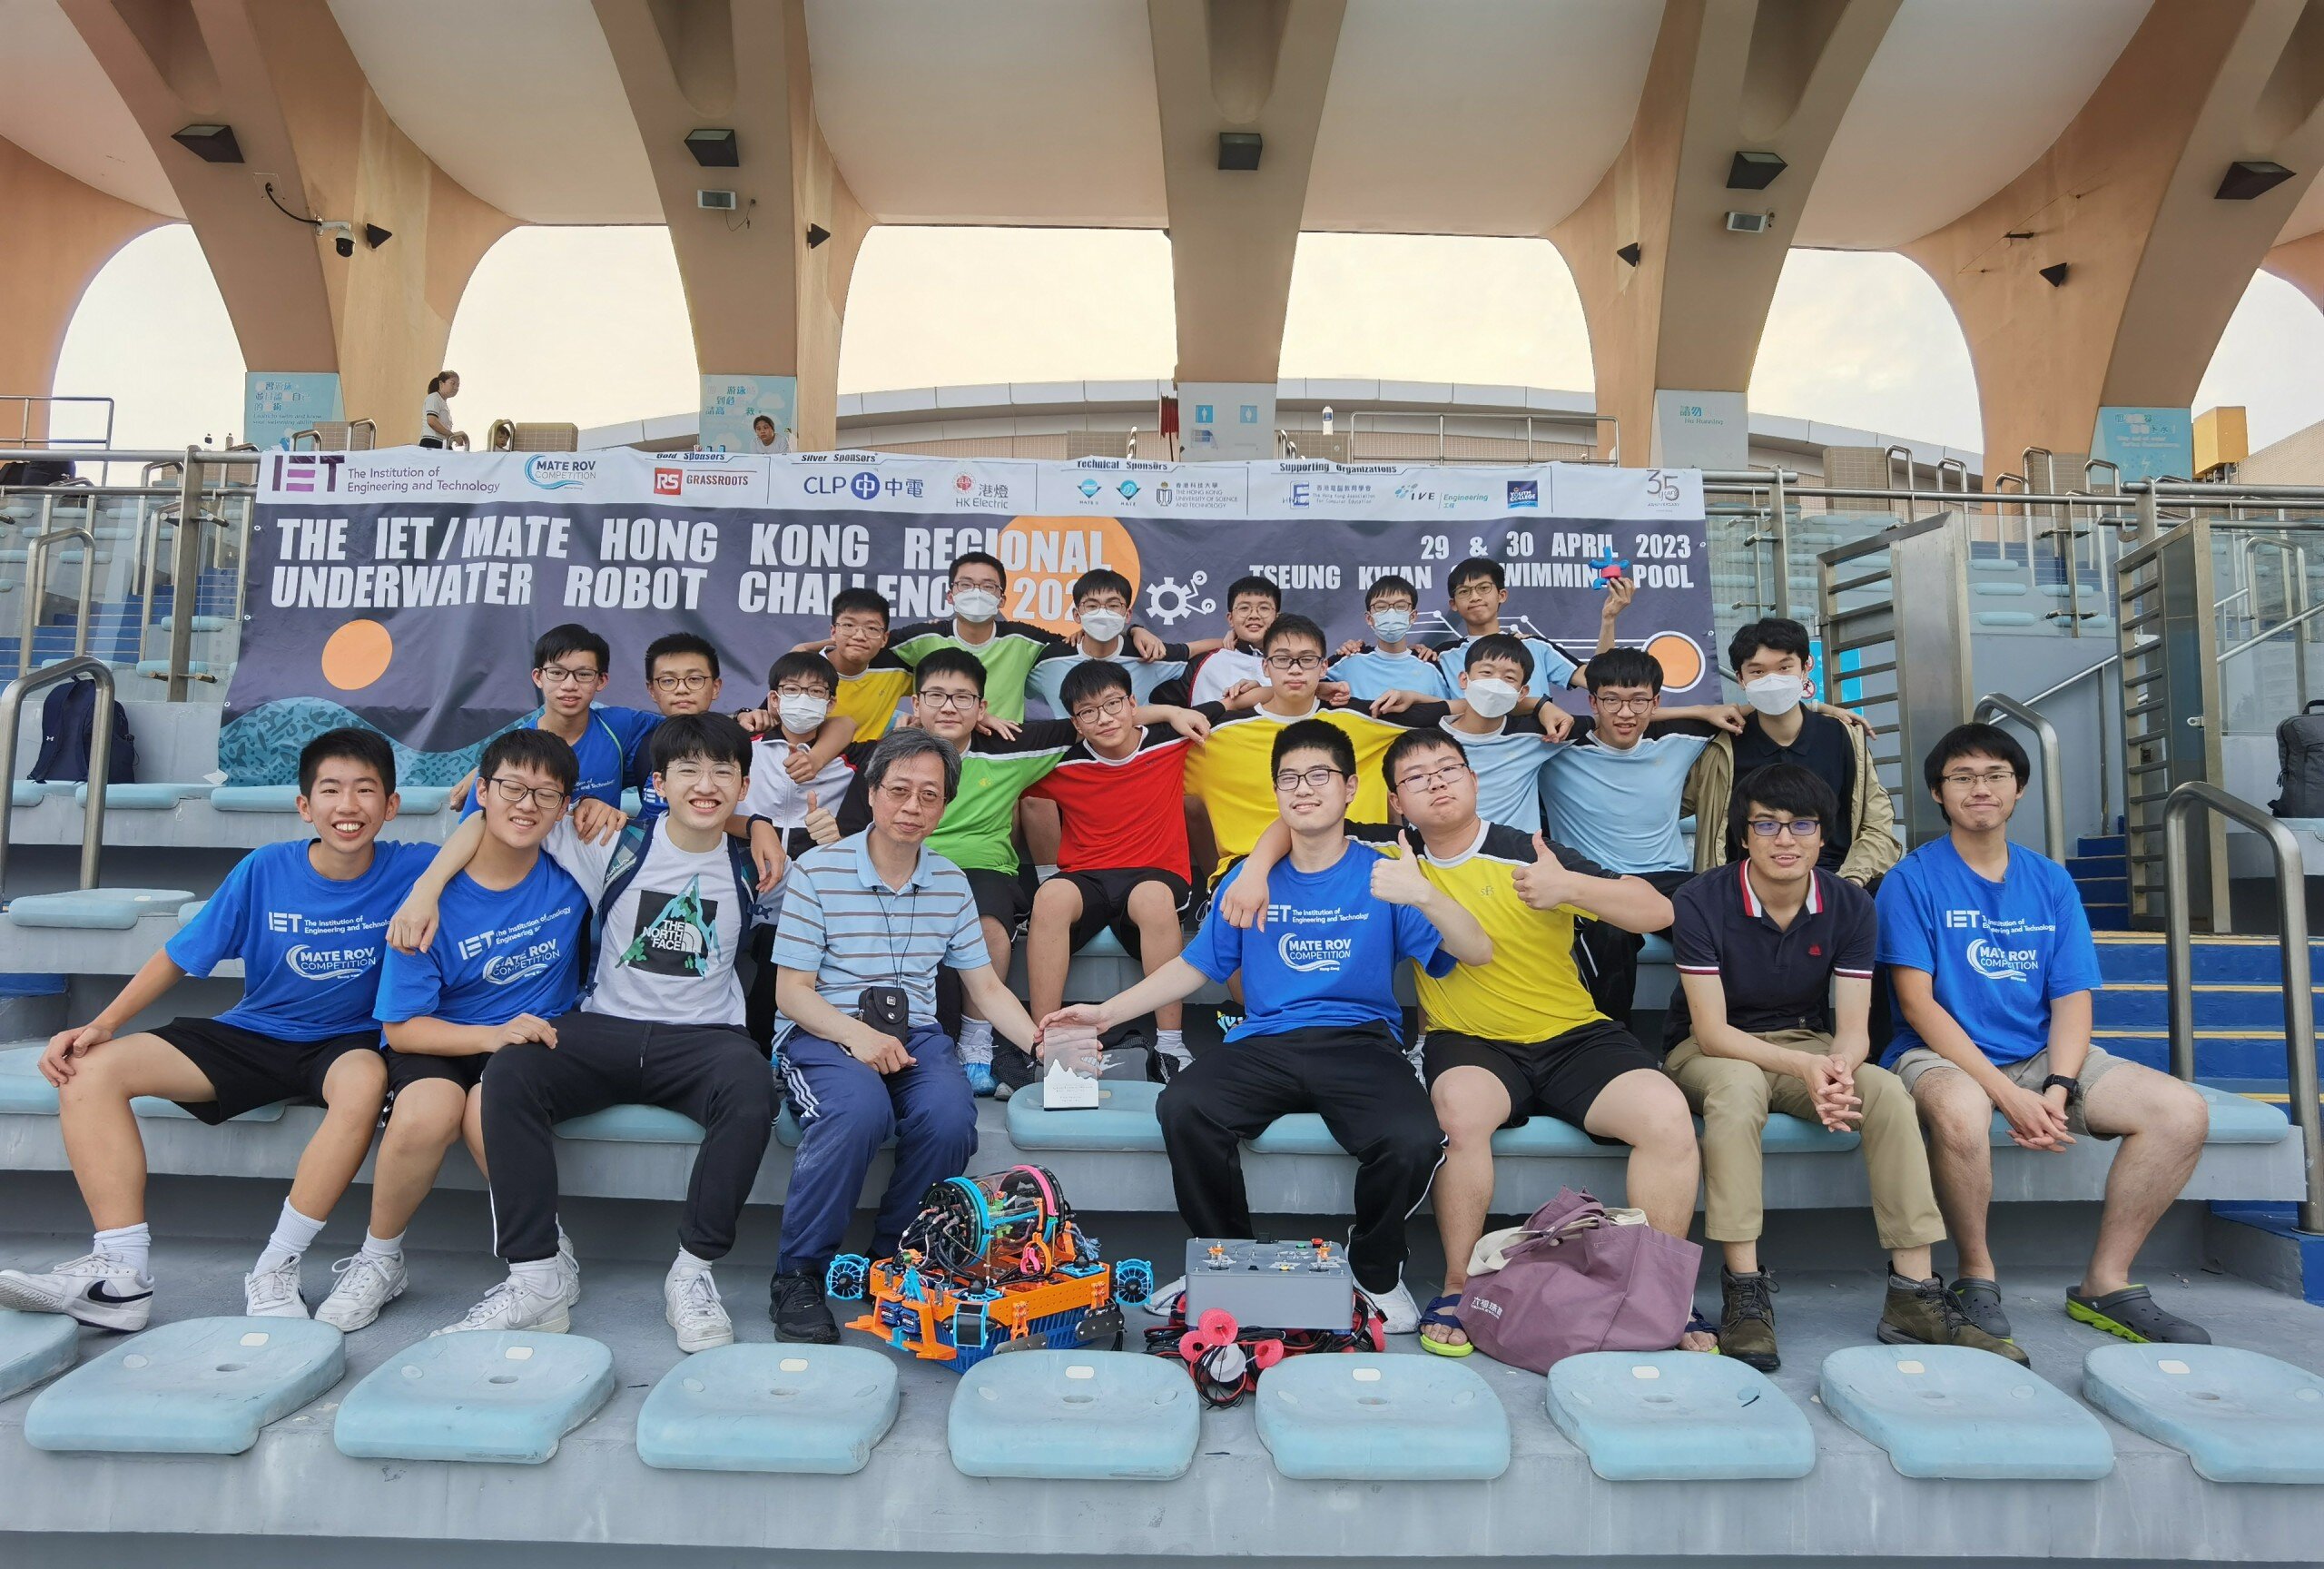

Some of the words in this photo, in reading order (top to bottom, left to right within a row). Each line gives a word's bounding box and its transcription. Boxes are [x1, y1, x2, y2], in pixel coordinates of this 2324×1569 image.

[537, 460, 569, 471] MATE
[572, 460, 596, 471] ROV
[684, 453, 725, 463] Sponsors
[801, 454, 828, 463] Silver
[833, 453, 876, 463] Sponsors
[1078, 459, 1119, 469] Technical
[1126, 460, 1167, 470] Sponsors
[272, 455, 345, 492] IET
[348, 469, 366, 479] The
[369, 467, 426, 479] Institution
[428, 466, 441, 478] of
[535, 471, 596, 479] COMPETITION
[1280, 462, 1329, 473] Supporting
[1336, 464, 1397, 474] Organizations
[348, 480, 409, 494] Engineering
[411, 480, 433, 491] and
[437, 479, 500, 494] Technology
[656, 473, 680, 489] RS
[686, 474, 749, 487] GRASSROOTS
[803, 476, 847, 495] CLP
[884, 478, 924, 498] 中電
[979, 484, 1009, 498] 港燈
[1411, 492, 1435, 500] IVE
[1443, 493, 1489, 502] Engineering
[955, 498, 971, 508] HK
[972, 498, 1009, 509] Electric
[277, 518, 349, 560] THE
[600, 518, 718, 563] HONG
[750, 522, 870, 567] KONG
[903, 527, 1111, 574] REGIONAL
[1421, 535, 1450, 560] 29
[1469, 536, 1489, 558] &
[1506, 531, 1534, 558] 30
[1551, 532, 1619, 558] APRIL
[1635, 533, 1691, 558] 2023
[1499, 562, 1600, 588] WIMMIN
[1632, 564, 1694, 589] POOL
[271, 561, 533, 608] UNDERWATER
[563, 565, 708, 610] ROBOT
[738, 571, 953, 617] CHALENG
[1012, 577, 1075, 621] 202
[1267, 904, 1292, 923] ET
[1293, 916, 1325, 924] Engineering
[1339, 913, 1369, 921] Technology
[1303, 908, 1333, 916] Institution
[1946, 910, 1980, 928] IET
[269, 911, 302, 933] IET
[304, 919, 317, 927] The
[319, 917, 354, 927] Institution
[355, 915, 363, 923] of
[305, 925, 346, 935] Engineering
[346, 923, 360, 932] and
[361, 920, 391, 930] Technolo
[508, 919, 539, 933] Institution
[663, 920, 685, 932] THE
[643, 926, 683, 942] NORTH
[2011, 925, 2023, 933] and
[496, 929, 534, 945] Engineering
[652, 937, 682, 951] FACE
[1289, 939, 1323, 951] MATE
[1325, 938, 1352, 950] ROV
[458, 930, 495, 961] IET
[529, 938, 556, 956] ROV
[300, 950, 340, 962] MATE
[344, 946, 376, 960] ROV
[1289, 950, 1351, 960] COMPETITION
[1980, 946, 2005, 958] MAT
[2008, 950, 2036, 962] ROV
[300, 956, 376, 971] COMPETITION
[493, 949, 560, 976] COMPETITION
